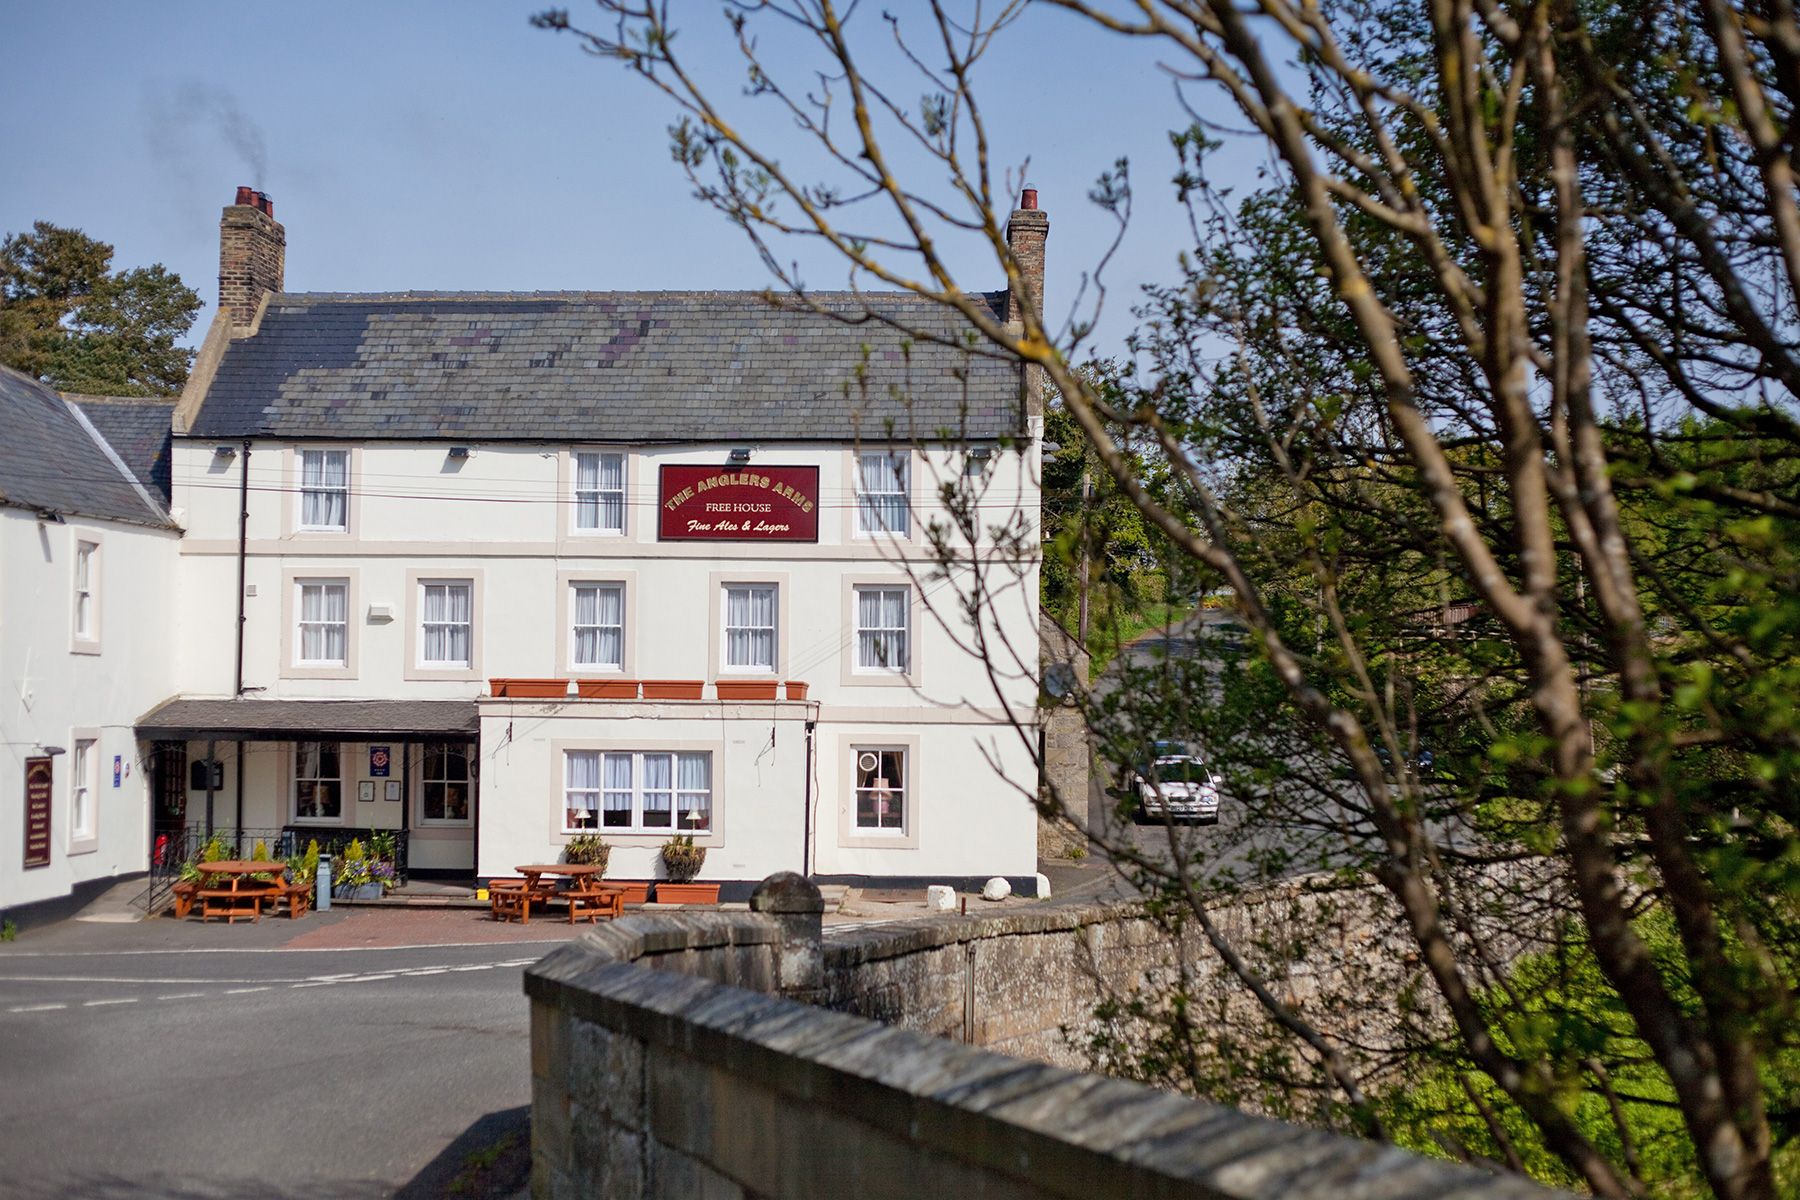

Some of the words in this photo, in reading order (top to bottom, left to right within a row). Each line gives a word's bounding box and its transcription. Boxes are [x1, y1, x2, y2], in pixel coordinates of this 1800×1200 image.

[664, 486, 695, 511] THE
[697, 473, 770, 493] ANGLERS
[772, 481, 813, 513] ARMS
[706, 503, 731, 512] FREE
[733, 503, 771, 513] HOUSE
[687, 519, 711, 532] Fine
[713, 520, 739, 532] Ales
[741, 520, 751, 531] &
[753, 520, 790, 534] Lagers
